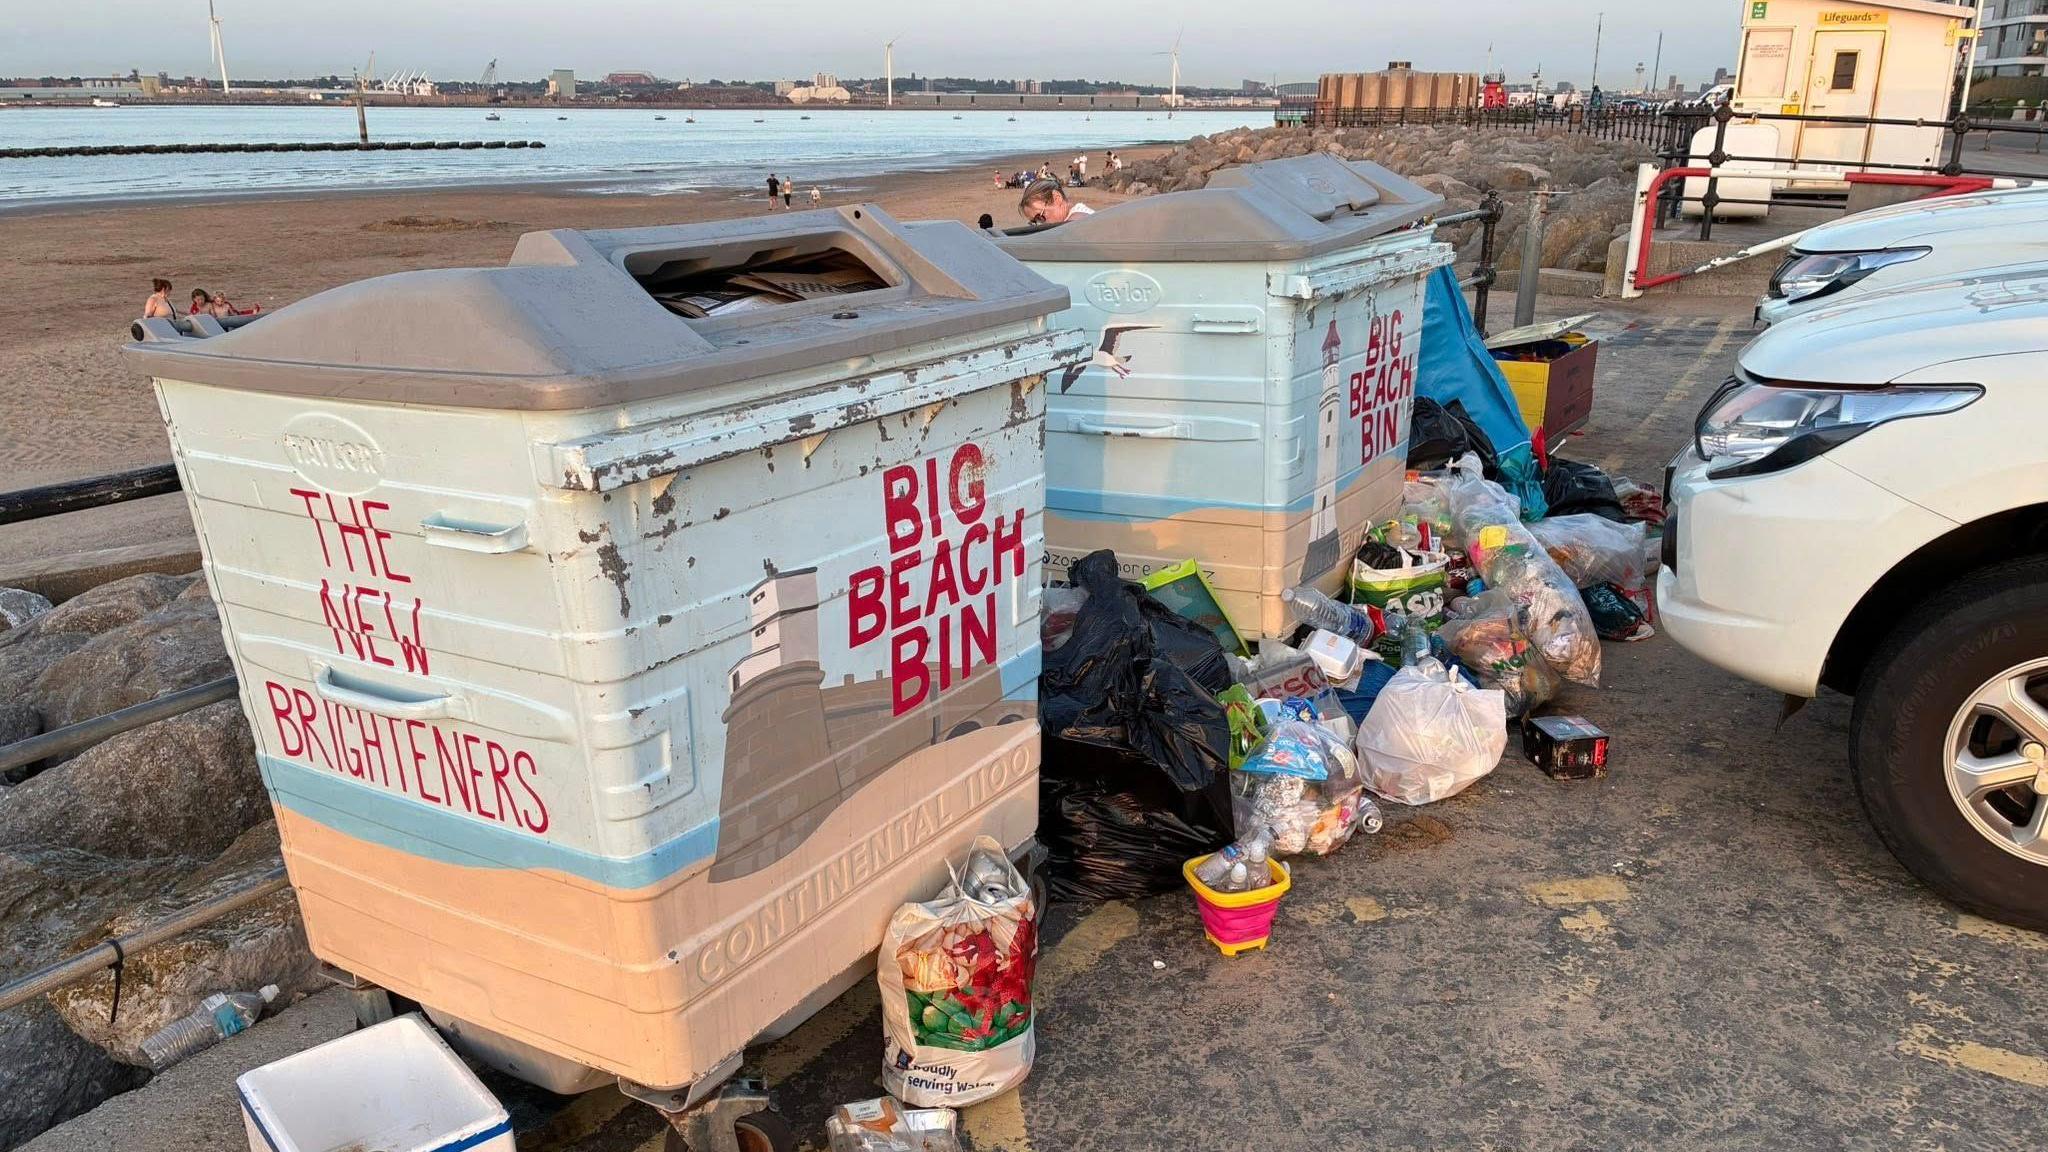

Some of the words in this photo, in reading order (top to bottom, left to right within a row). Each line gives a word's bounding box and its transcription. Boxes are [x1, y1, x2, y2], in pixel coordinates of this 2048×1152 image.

[1824, 12, 1872, 24] Lifeguards
[1092, 280, 1153, 306] Taylor
[1365, 309, 1403, 367] BIG
[1349, 353, 1413, 419] BEACH
[284, 434, 378, 474] TAYLOR
[1362, 404, 1399, 466] BIN
[884, 443, 987, 555] BIG
[290, 488, 412, 584] THE
[849, 508, 1026, 650] BEACH
[319, 578, 431, 677] NEW
[890, 593, 999, 719] BIN
[265, 681, 551, 835] BRIGHTENERS
[697, 792, 954, 984] CONTINENTAL
[962, 744, 1033, 812] 1100
[907, 1075, 953, 1095] serving
[910, 1064, 958, 1081] oudly
